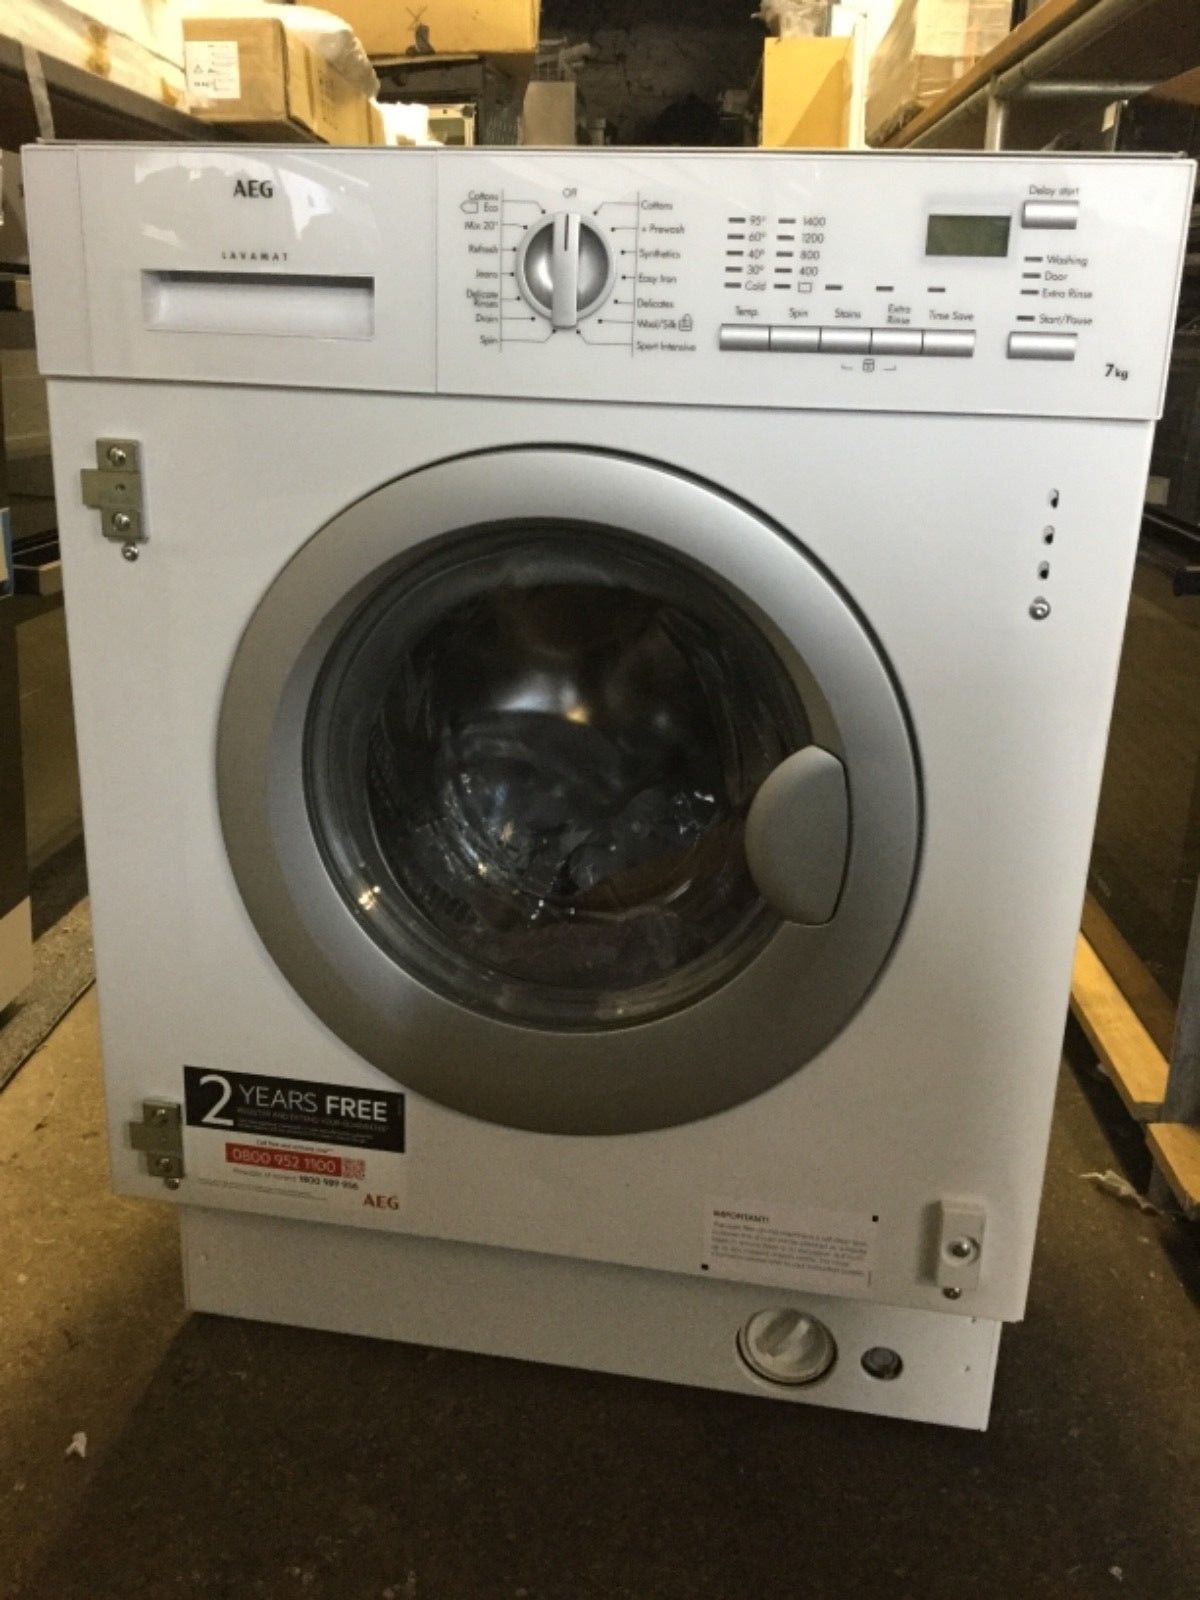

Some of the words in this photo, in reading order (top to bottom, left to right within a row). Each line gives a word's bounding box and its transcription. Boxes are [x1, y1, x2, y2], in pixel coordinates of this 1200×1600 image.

[233, 179, 273, 198] AEG
[562, 187, 577, 198] Off
[1029, 184, 1056, 197] Delay
[803, 215, 826, 227] 1400
[801, 232, 825, 244] 1200
[221, 250, 288, 261] LAVAMAT
[1046, 254, 1089, 268] Washing
[799, 265, 819, 277] 400
[1044, 270, 1069, 281] Door
[1067, 288, 1094, 300] Rinse
[789, 307, 809, 319] Spin
[952, 310, 975, 322] Save
[199, 1074, 235, 1127] 2
[238, 1083, 319, 1114] YEARS
[325, 1095, 389, 1123] FREE
[232, 1148, 271, 1165] 0800
[274, 1154, 300, 1169] 952
[362, 1192, 400, 1211] AEG
